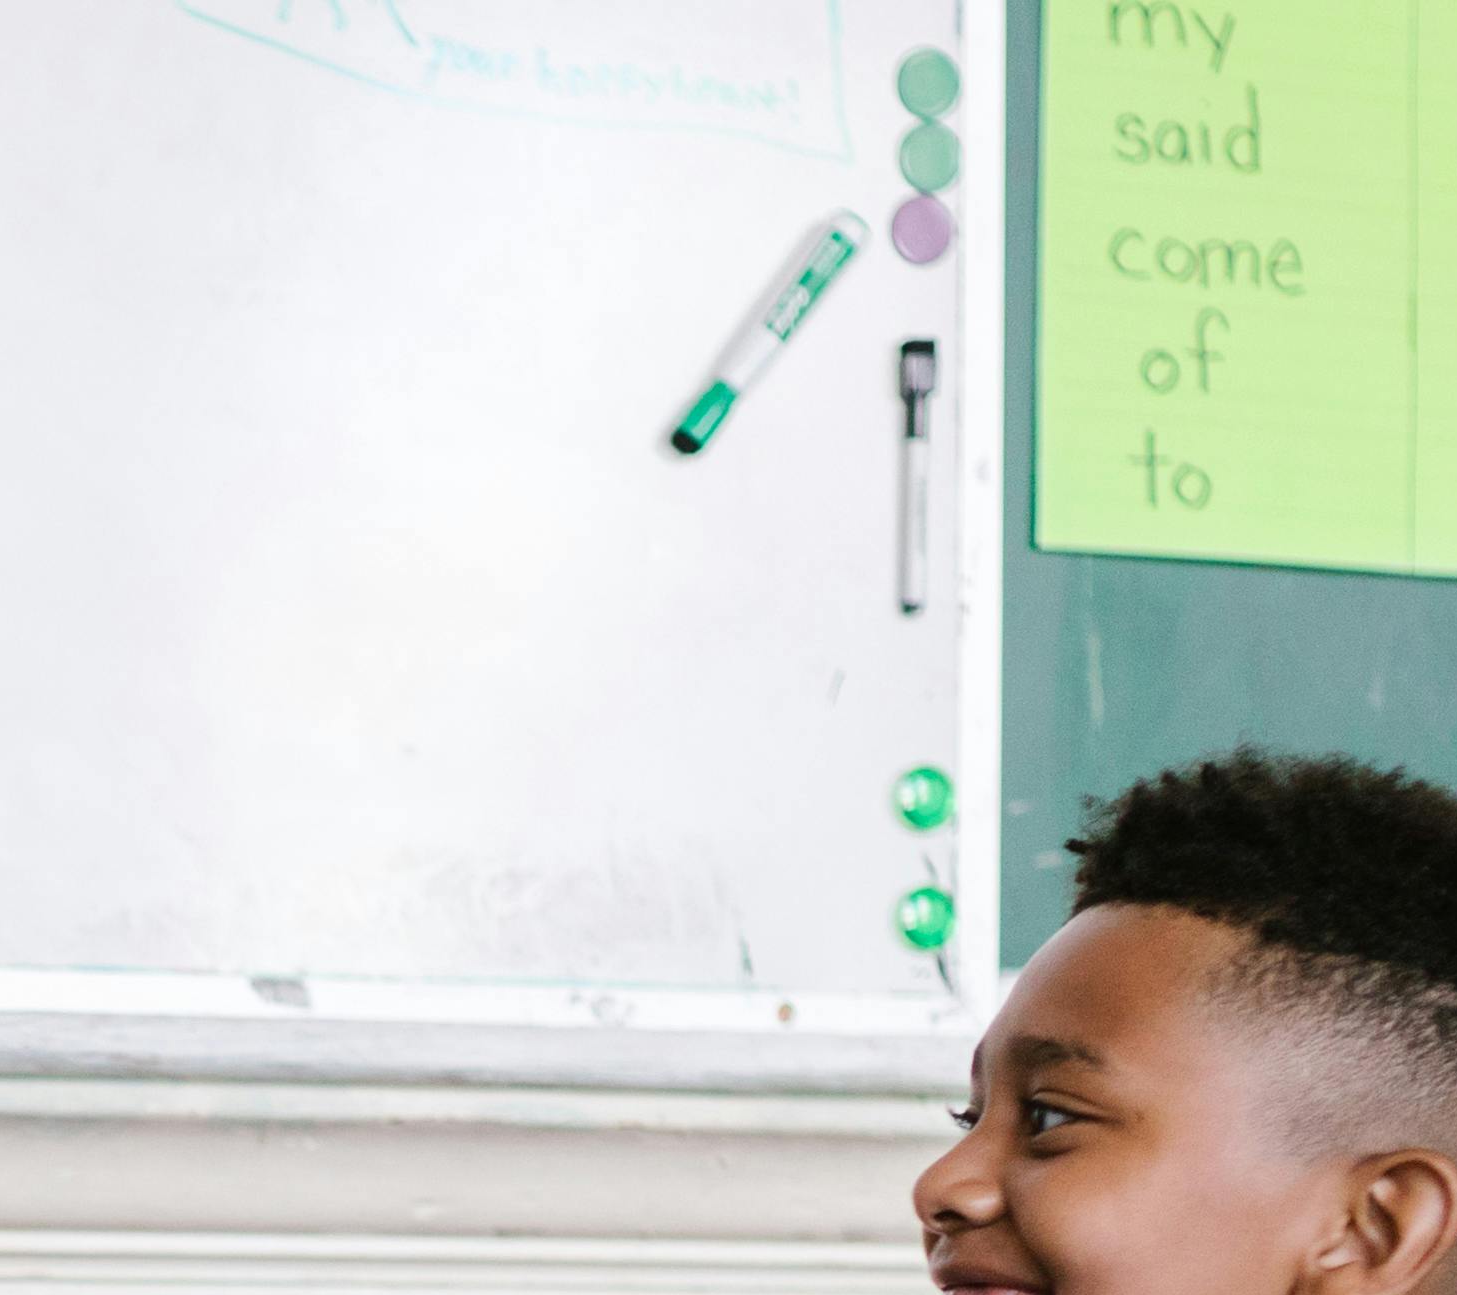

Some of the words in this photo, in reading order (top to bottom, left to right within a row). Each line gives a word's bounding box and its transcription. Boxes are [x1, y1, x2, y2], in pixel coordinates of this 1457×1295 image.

[1108, 0, 1236, 74] my
[1111, 86, 1264, 175] said
[1109, 223, 1307, 300] come
[1139, 308, 1229, 394] of
[1129, 429, 1213, 510] to
